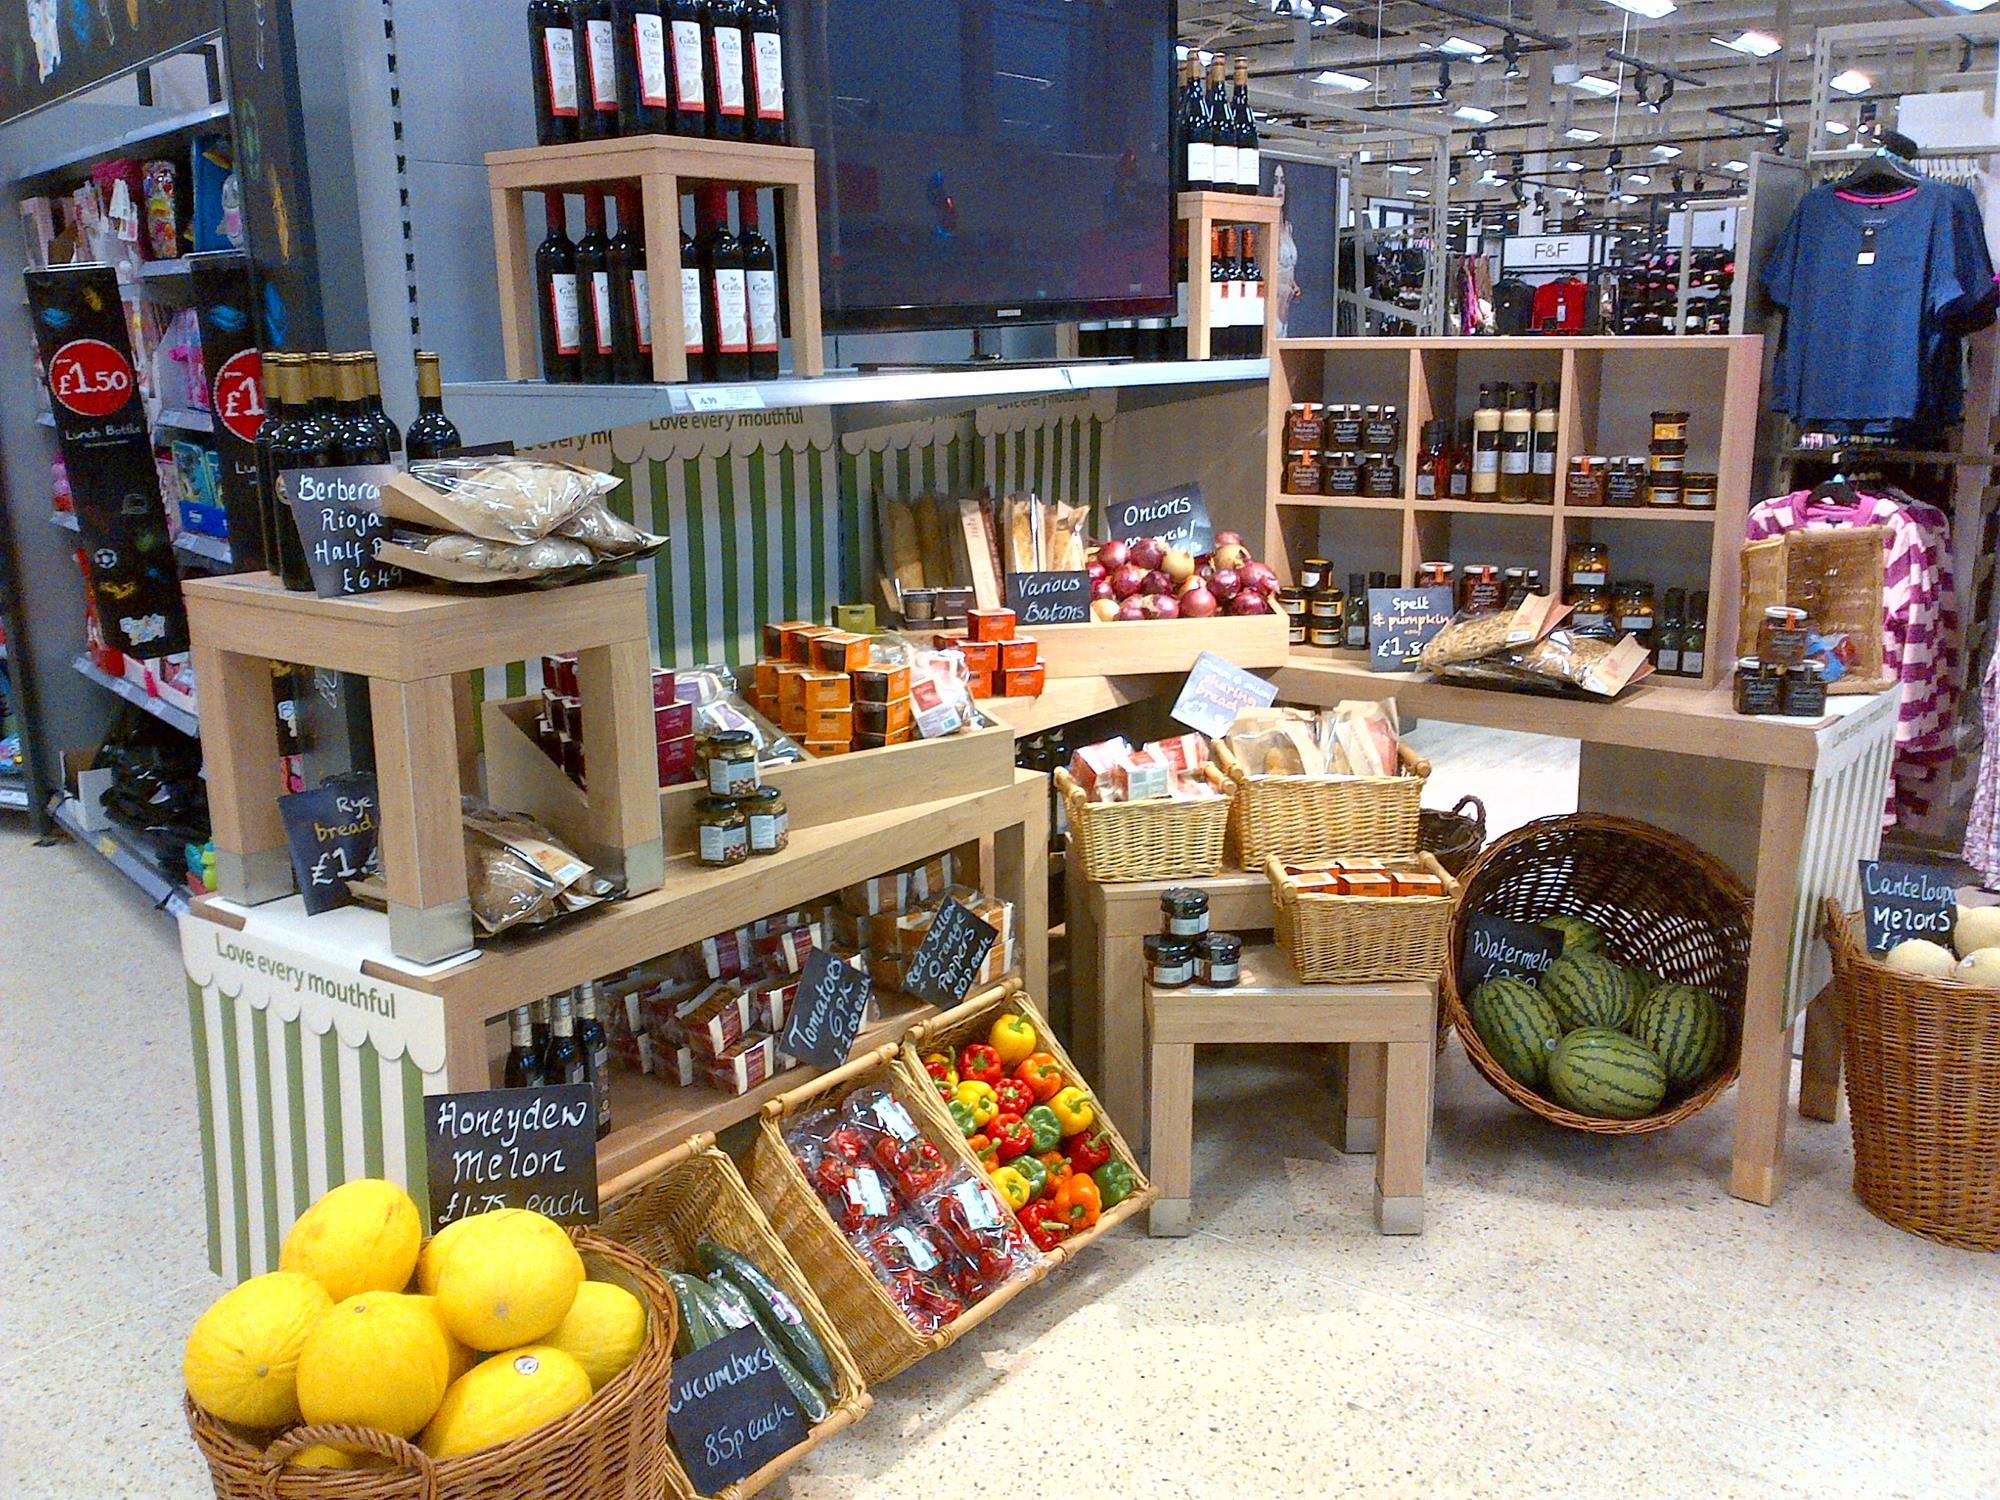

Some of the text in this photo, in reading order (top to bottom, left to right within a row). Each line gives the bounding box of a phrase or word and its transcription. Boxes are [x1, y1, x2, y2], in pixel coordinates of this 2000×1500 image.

[1535, 242, 1569, 259] F&F
[649, 405, 804, 432] Love every mouthful
[320, 508, 383, 537] Rioja
[1123, 496, 1192, 526] Onions
[314, 539, 365, 567] Half
[1019, 575, 1080, 598] Various
[1023, 601, 1085, 623] Batons
[1392, 595, 1430, 616] Spelt
[1388, 612, 1450, 632] pumpkin
[336, 796, 374, 819] Rye
[314, 813, 374, 842] bread
[1873, 906, 1951, 932] Melons
[937, 927, 975, 992] Peppers
[215, 932, 396, 1019] Love every mouthful
[788, 957, 842, 1049] Tomatoes
[437, 1097, 587, 1148] Honeydew
[452, 1146, 567, 1185] Melon
[526, 1188, 592, 1217] each
[704, 1402, 795, 1467] 85p each
